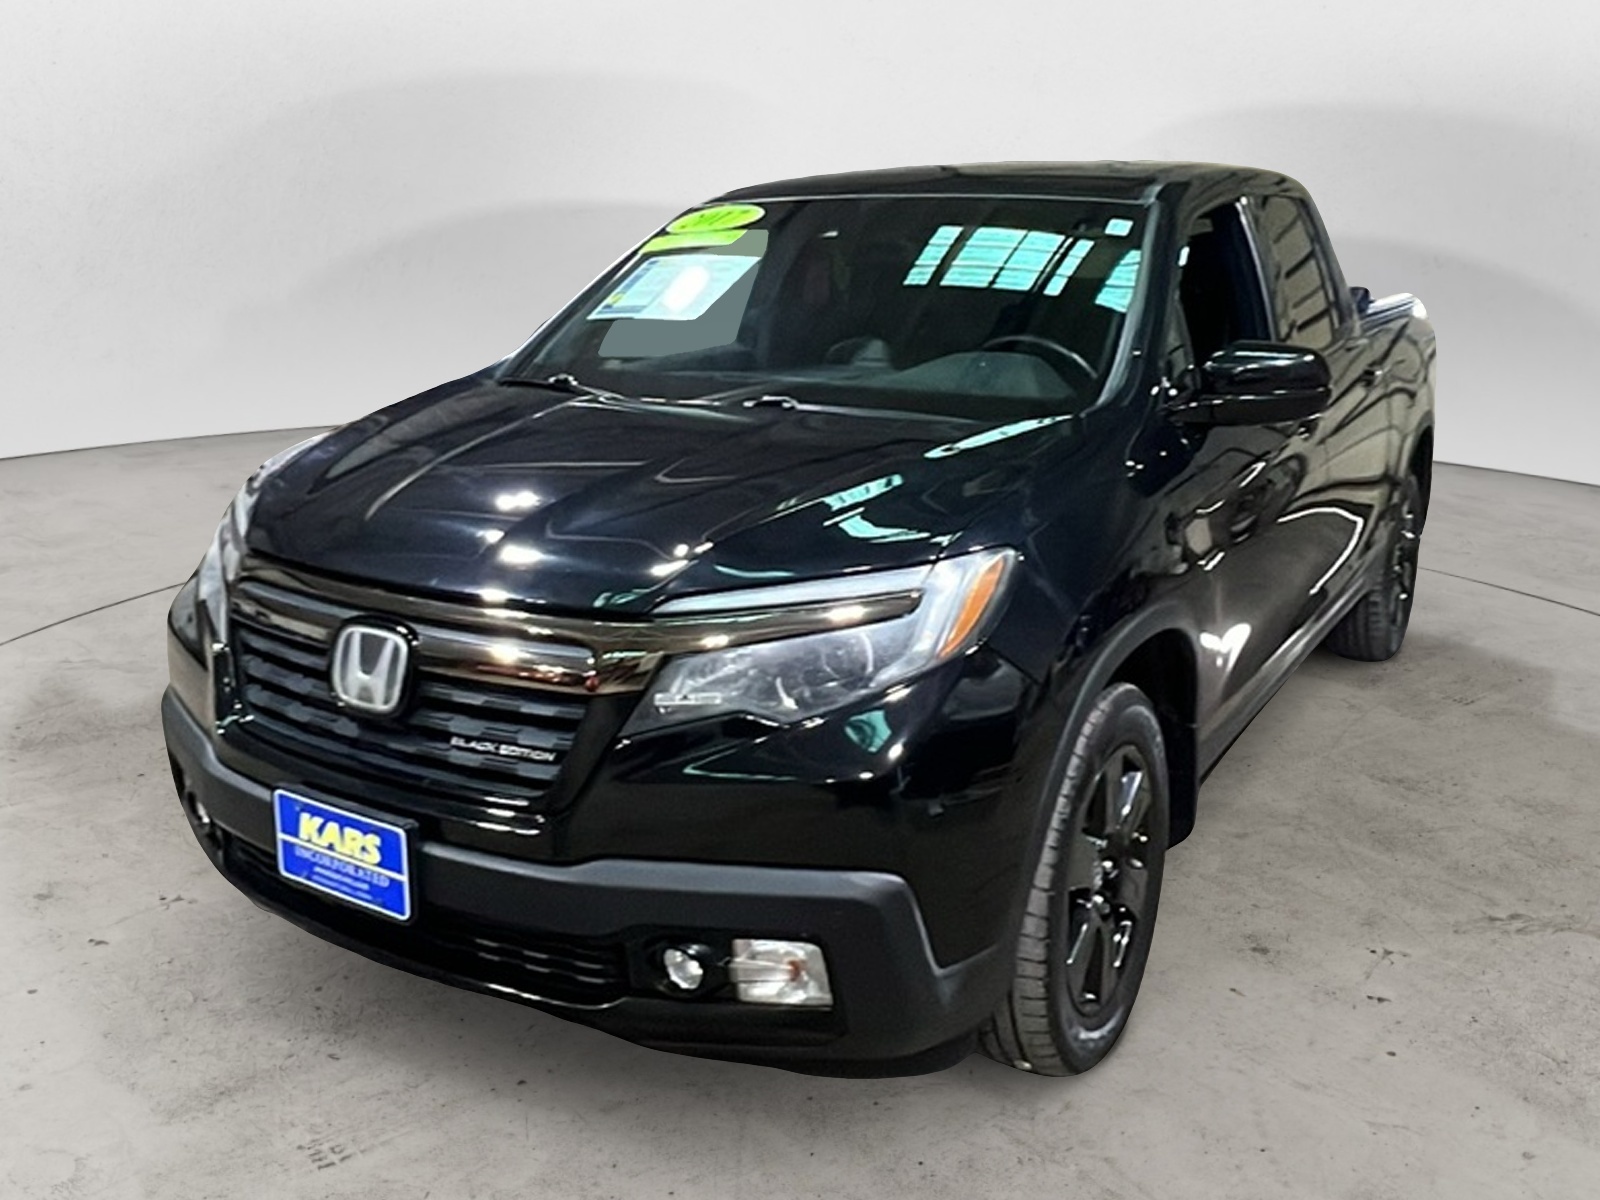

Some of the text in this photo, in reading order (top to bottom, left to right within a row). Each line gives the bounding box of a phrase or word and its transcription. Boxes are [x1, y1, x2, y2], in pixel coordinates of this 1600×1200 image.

[451, 736, 557, 761] BLACK EDITION
[298, 812, 382, 866] KARS
